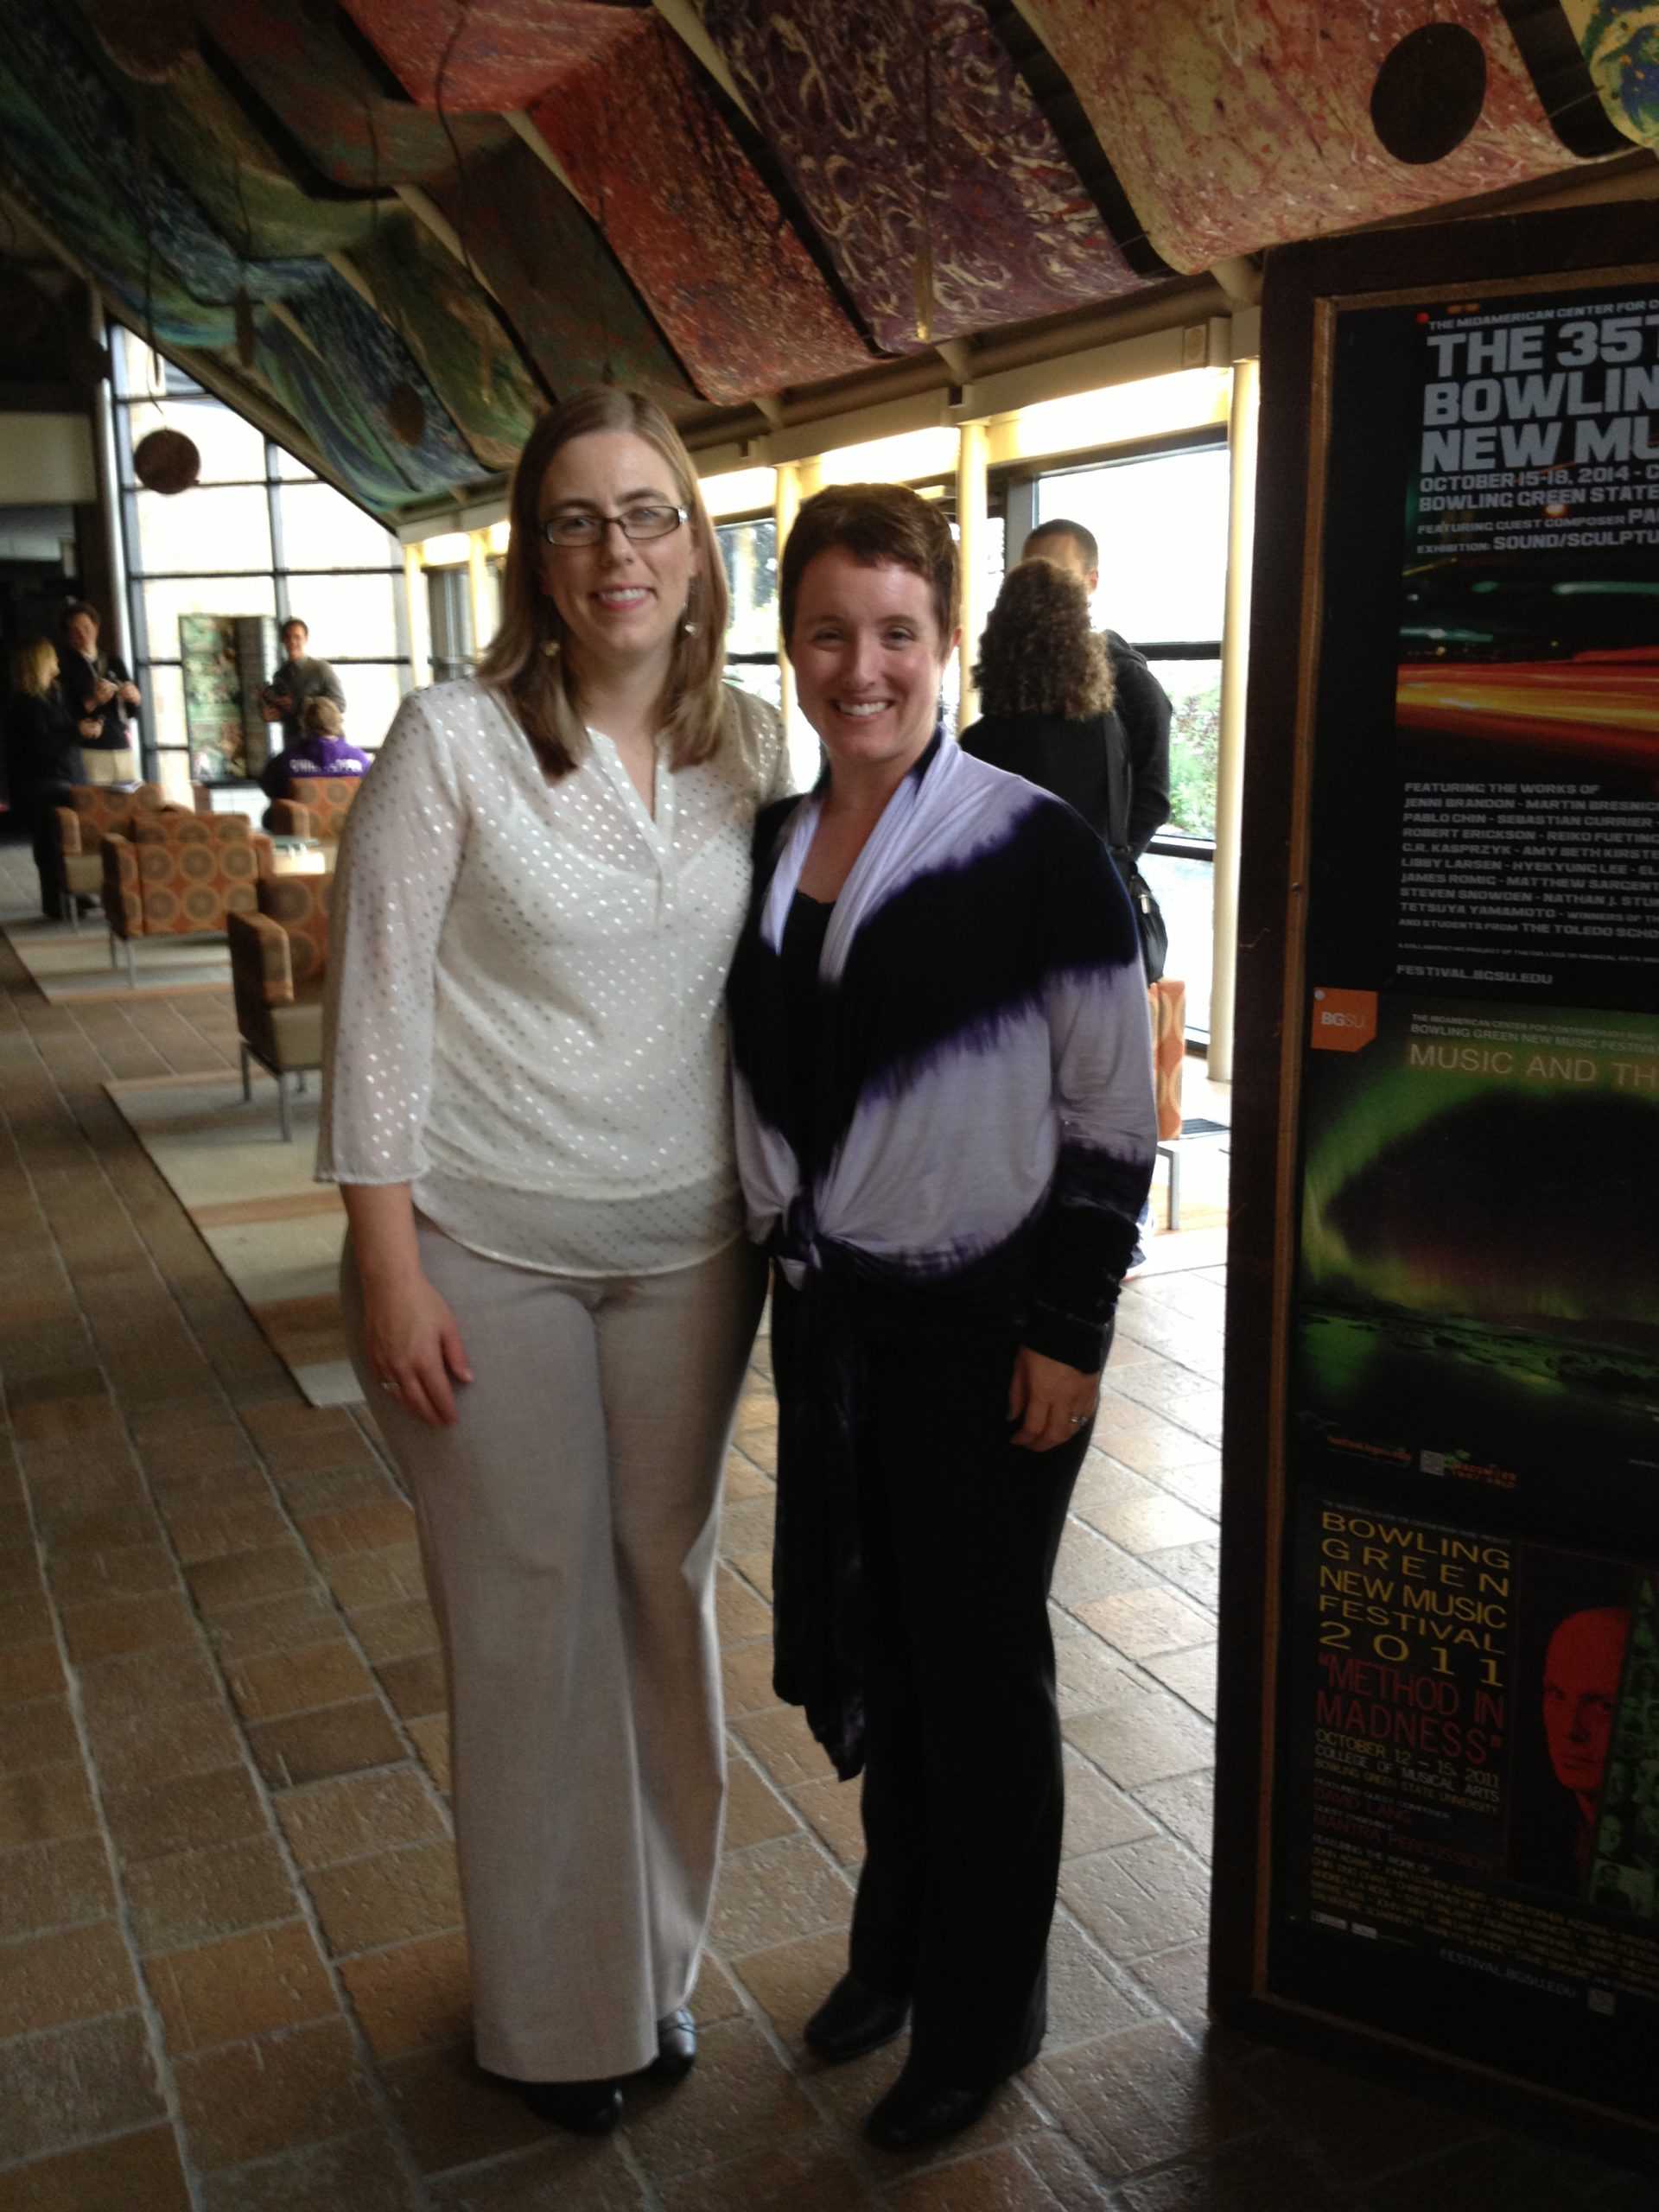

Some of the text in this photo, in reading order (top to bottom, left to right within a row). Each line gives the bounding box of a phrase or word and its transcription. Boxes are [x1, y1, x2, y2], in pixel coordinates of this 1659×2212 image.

[1429, 318, 1455, 331] THE
[1457, 311, 1554, 328] MIDAMERICAN
[1557, 303, 1614, 319] CENTER
[1616, 301, 1645, 313] FOR
[1427, 325, 1545, 378] THE
[1423, 364, 1659, 426] BOWLIN
[1421, 422, 1563, 474] NEW
[1420, 473, 1516, 493] OCTOBER
[1577, 467, 1630, 484] 2014
[1419, 484, 1659, 512] BOWLING GREEN STATE
[1417, 521, 1494, 534] FEATURING
[1495, 518, 1541, 531] GUEST
[1543, 514, 1625, 528] COMPOSER
[1404, 783, 1600, 794] FEATURING THE WORKS OF
[1403, 813, 1451, 823] PABLO
[1452, 814, 1486, 823] CHIN
[1496, 814, 1581, 825] SEBASTIAN
[1583, 816, 1653, 828] CURRIER
[1402, 828, 1459, 838] ROBERT
[1461, 829, 1535, 840] ERICKSON
[1546, 830, 1592, 842] REIKO
[1400, 887, 1454, 898] STEVEN
[1457, 889, 1532, 901] SNOWDEN
[1542, 893, 1605, 905] NATHAN
[1400, 902, 1466, 914] TETSUYA
[1469, 905, 1556, 918] YAMAMOTO
[1423, 919, 1483, 930] STUDENTS
[1484, 922, 1518, 931] FROM
[1521, 922, 1550, 933] THE
[1553, 924, 1614, 937] TOLEDO
[1396, 963, 1554, 984] FESTIVAL.BGSU.EDU
[1320, 1011, 1364, 1028] BGSU
[1410, 1023, 1470, 1038] BOWLING
[1472, 1029, 1518, 1042] GREEN
[1521, 1033, 1554, 1045] NEW
[1555, 1036, 1599, 1049] MUSIC
[1410, 1044, 1513, 1075] MUSIC
[1525, 1055, 1597, 1082] AND
[1321, 1511, 1510, 1571] BOWLING
[1319, 1565, 1507, 1630] NEW MUSIC
[1319, 1594, 1505, 1656] FESTIVAL
[1473, 1690, 1504, 1728] IN
[1314, 1728, 1387, 1757] OCTOBER
[1395, 1748, 1412, 1765] 12
[1465, 1768, 1500, 1788] 2011
[1314, 1744, 1500, 1802] COLLEGE OF MUSICAL ARTS
